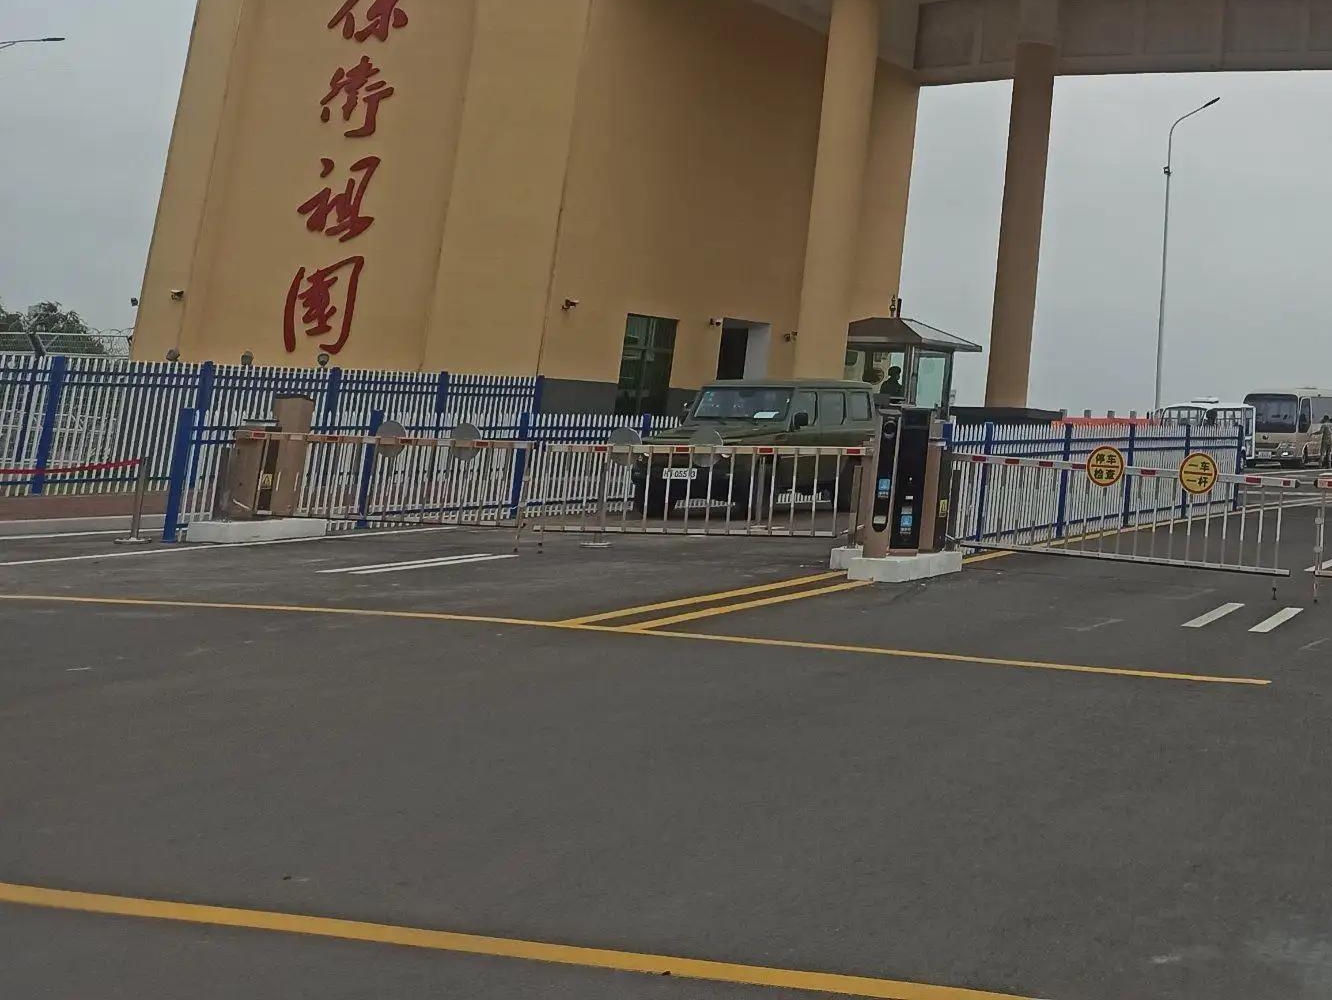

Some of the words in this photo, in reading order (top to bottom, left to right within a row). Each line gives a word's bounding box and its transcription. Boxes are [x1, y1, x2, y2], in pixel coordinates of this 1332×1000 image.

[1095, 453, 1117, 464] 停车
[1188, 461, 1210, 472] 一车
[1093, 469, 1116, 480] 检查
[1186, 476, 1209, 487] 一杆
